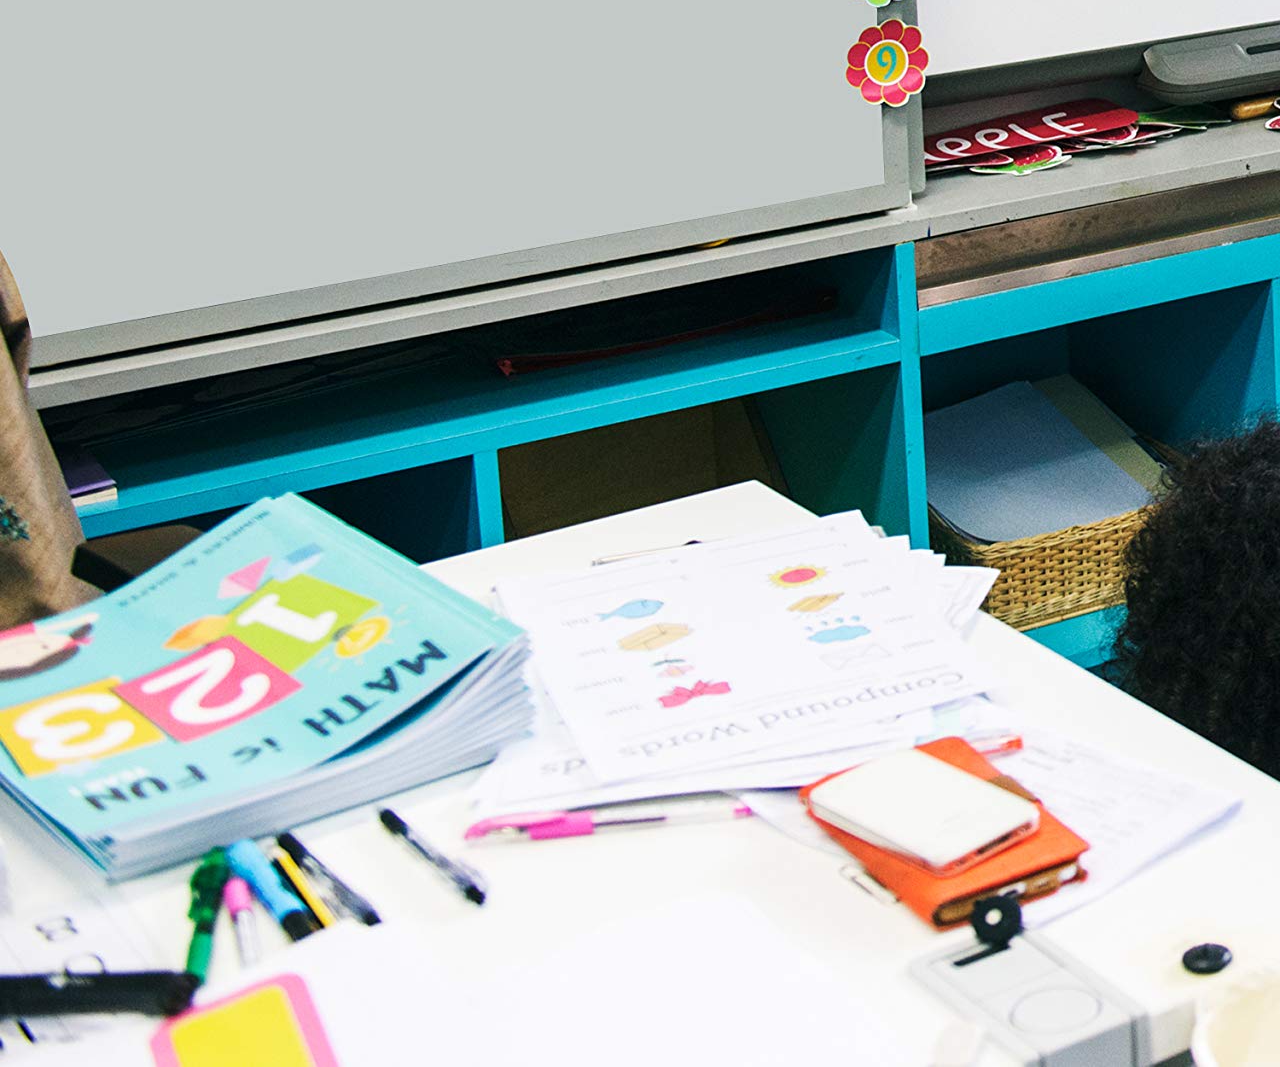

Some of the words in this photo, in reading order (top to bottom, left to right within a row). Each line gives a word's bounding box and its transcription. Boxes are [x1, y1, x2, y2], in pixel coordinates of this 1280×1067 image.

[876, 45, 896, 80] 9
[236, 592, 339, 643] 1
[141, 648, 271, 724] 2
[301, 639, 448, 737] MATH
[757, 670, 965, 730] Compound
[14, 692, 136, 761] 3
[617, 720, 750, 760] Words
[82, 763, 209, 812] FUN
